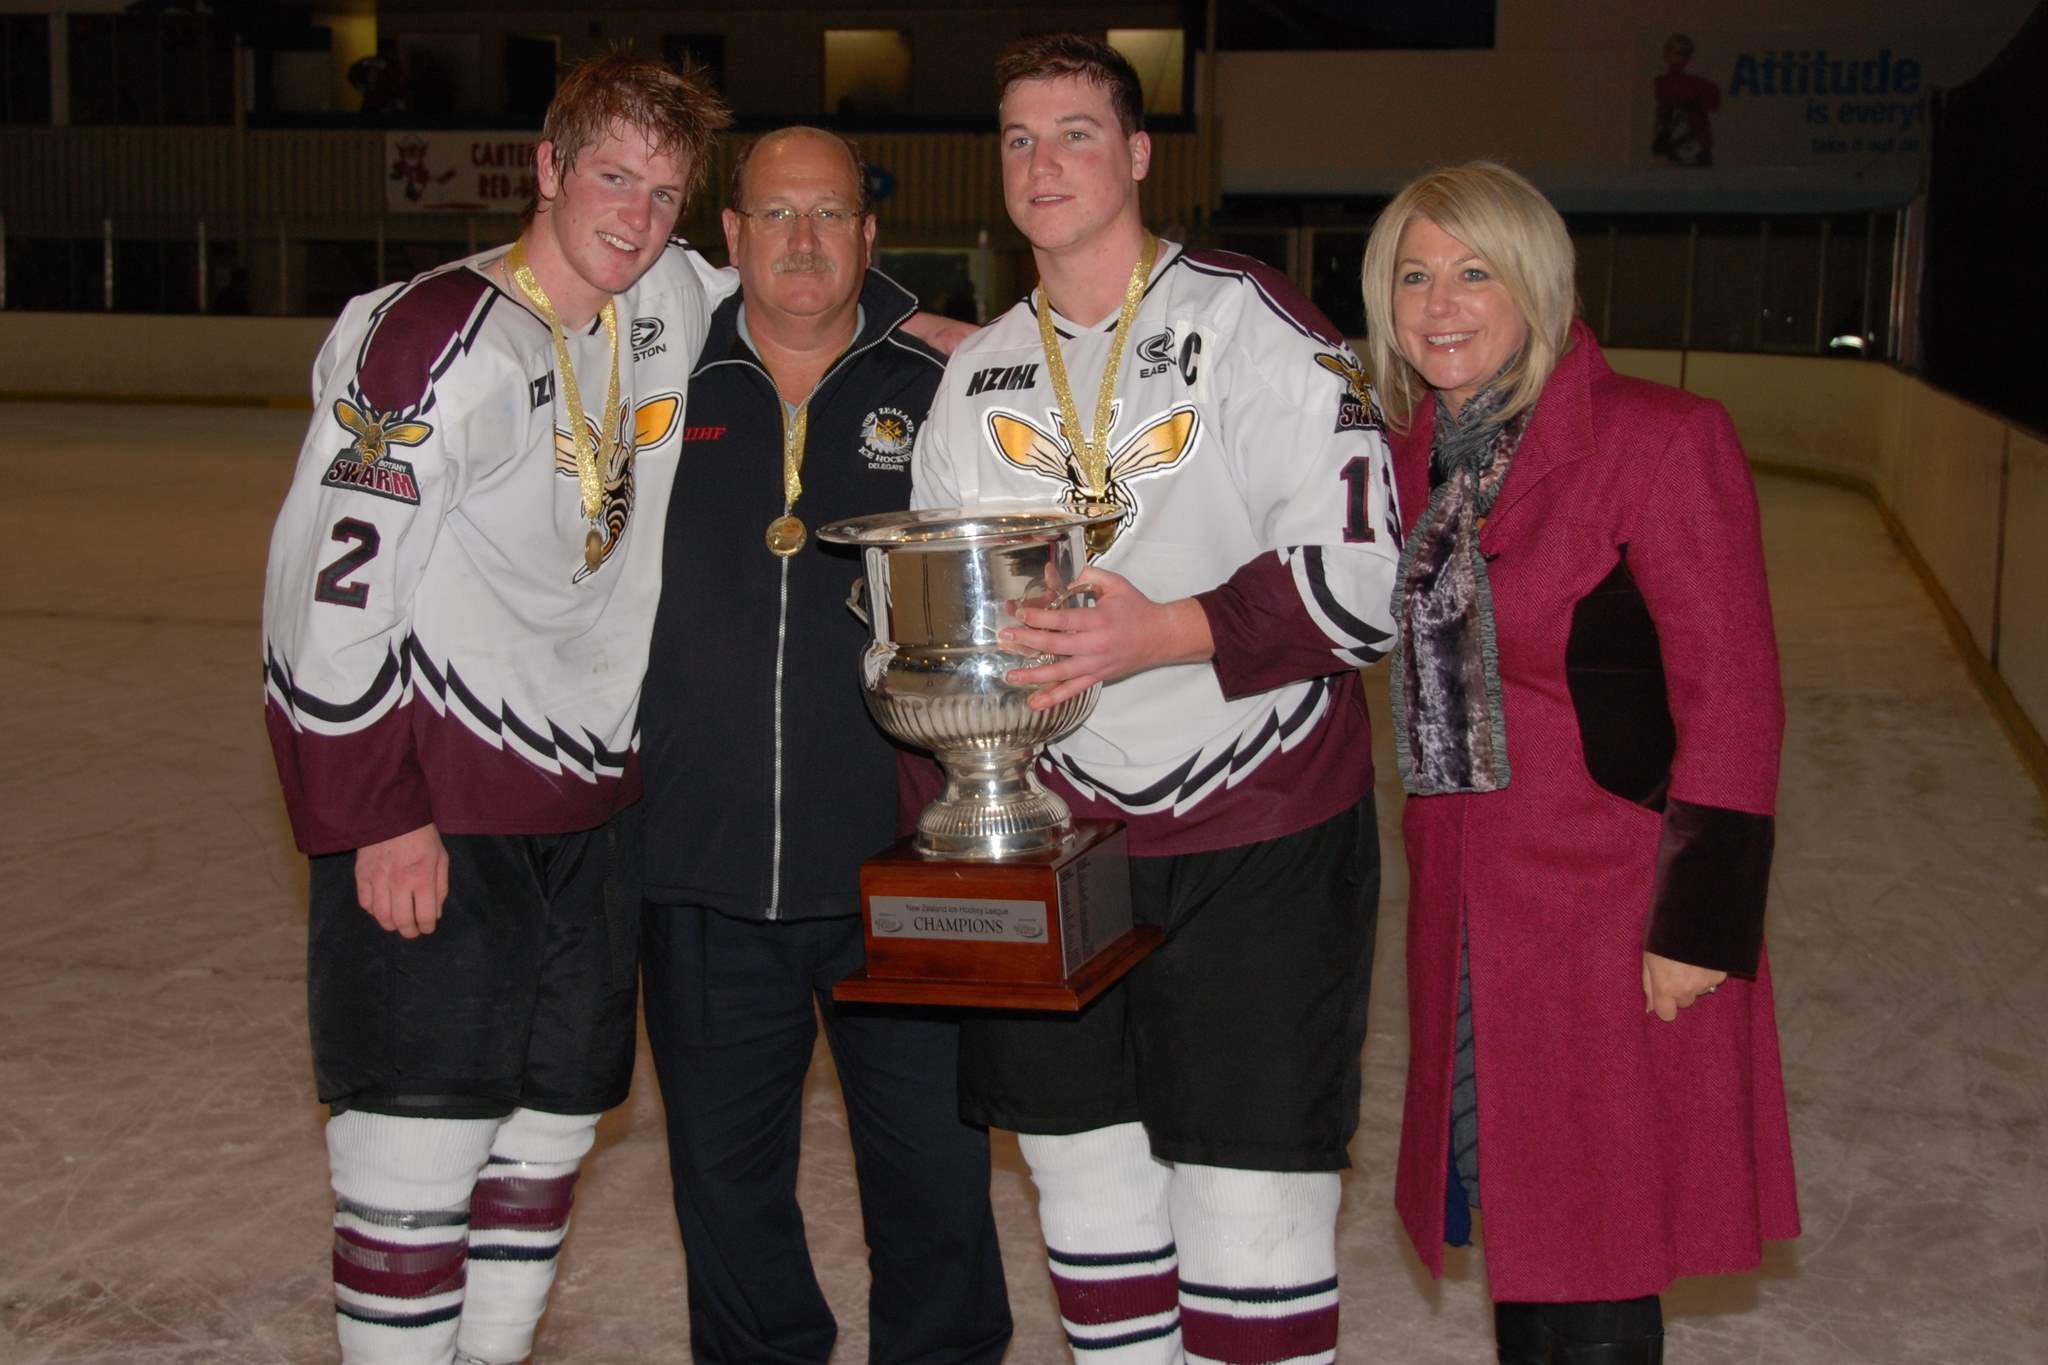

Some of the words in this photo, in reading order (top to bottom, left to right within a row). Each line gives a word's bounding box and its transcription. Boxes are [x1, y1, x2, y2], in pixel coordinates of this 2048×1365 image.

[1729, 49, 1920, 96] Attitude
[1807, 99, 1828, 124] is
[1839, 102, 1924, 131] every
[1140, 362, 1170, 378] EAS
[1178, 331, 1202, 386] C
[965, 364, 1039, 396] NZIHL
[684, 425, 729, 441] IIHF
[328, 459, 418, 500] SWARM
[378, 460, 408, 473] BOTANY
[315, 516, 381, 609] 2
[913, 916, 1004, 934] CHAMPIONS
[921, 904, 947, 913] Zealand
[959, 906, 983, 915] Hockey
[985, 906, 1008, 916] League
